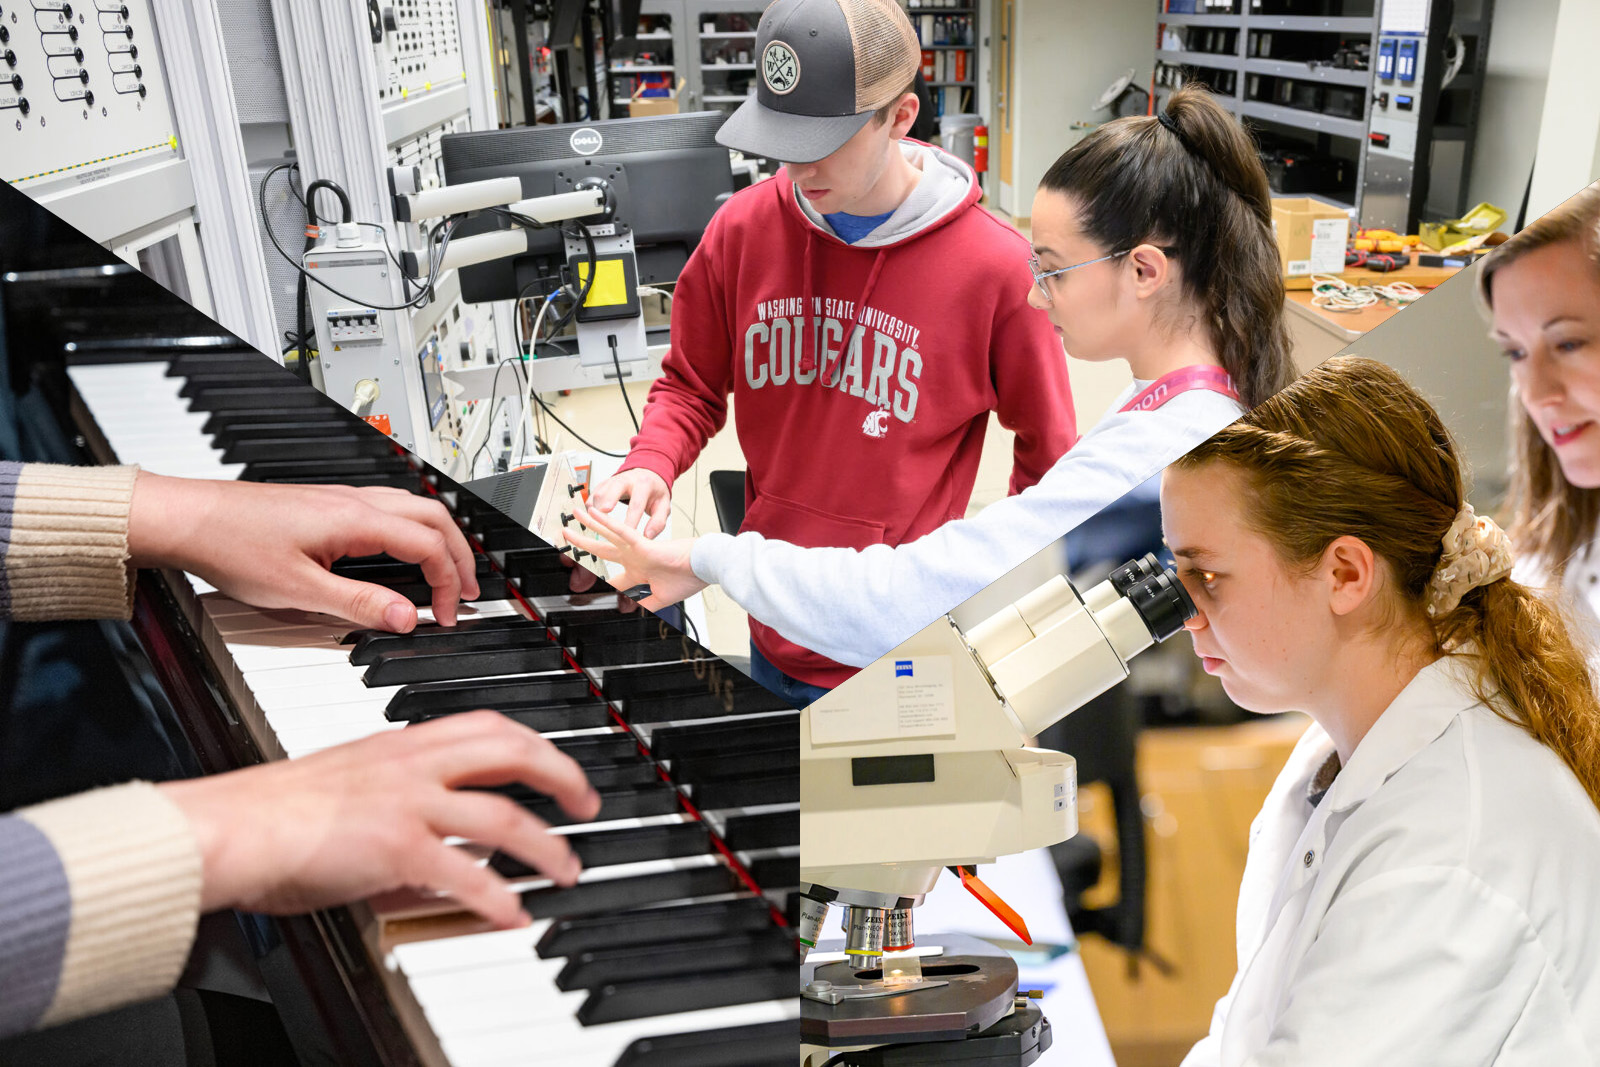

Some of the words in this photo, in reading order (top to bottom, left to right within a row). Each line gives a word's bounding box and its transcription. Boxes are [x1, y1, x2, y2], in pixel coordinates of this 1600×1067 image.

[767, 61, 775, 72] W
[786, 66, 794, 77] A
[574, 136, 599, 146] DELL
[757, 296, 821, 321] WASHINGN
[825, 298, 855, 320] STATE
[858, 306, 920, 347] UNIVERSITY
[744, 316, 923, 424] COUGARS
[886, 912, 908, 920] ZEISS
